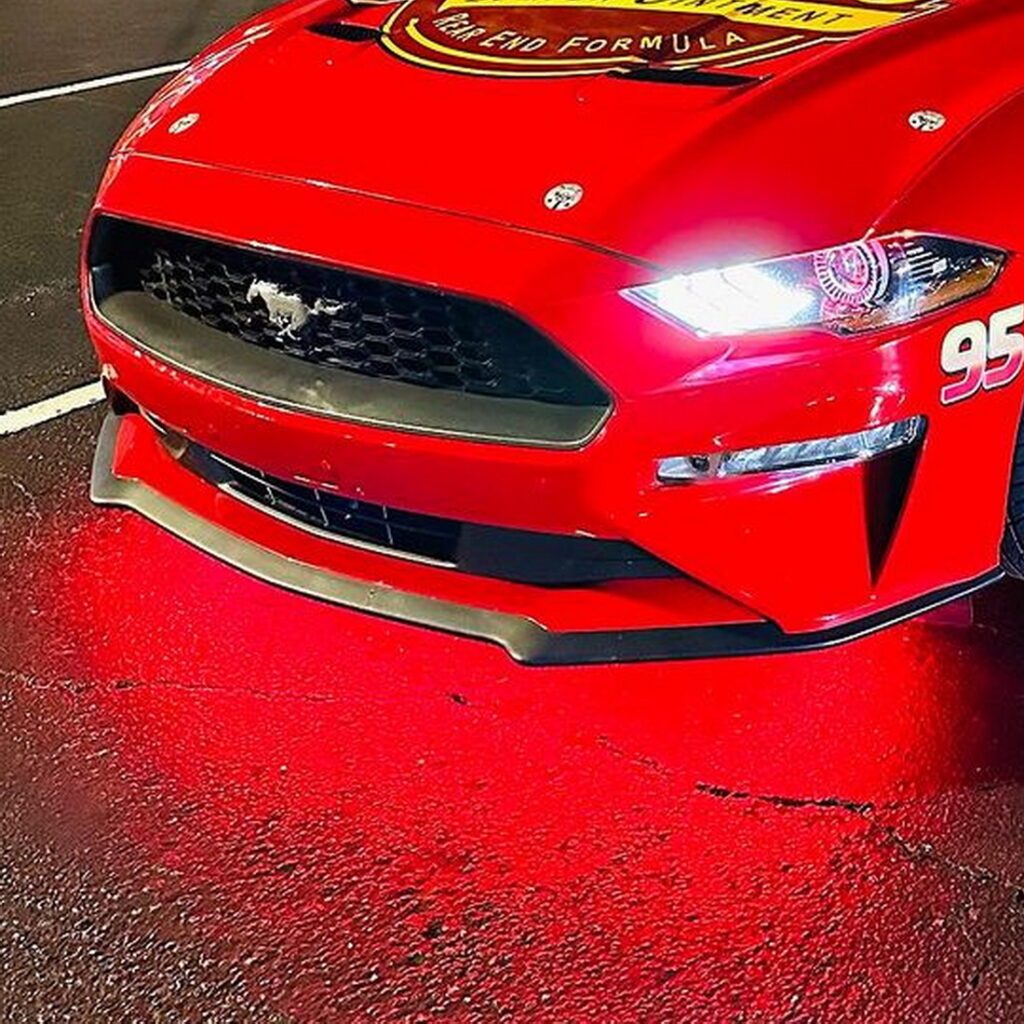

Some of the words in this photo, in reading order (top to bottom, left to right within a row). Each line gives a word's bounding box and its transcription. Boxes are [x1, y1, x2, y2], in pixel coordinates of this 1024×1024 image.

[432, 11, 486, 43] REAR
[478, 29, 548, 54] END
[556, 31, 747, 55] FORMULA
